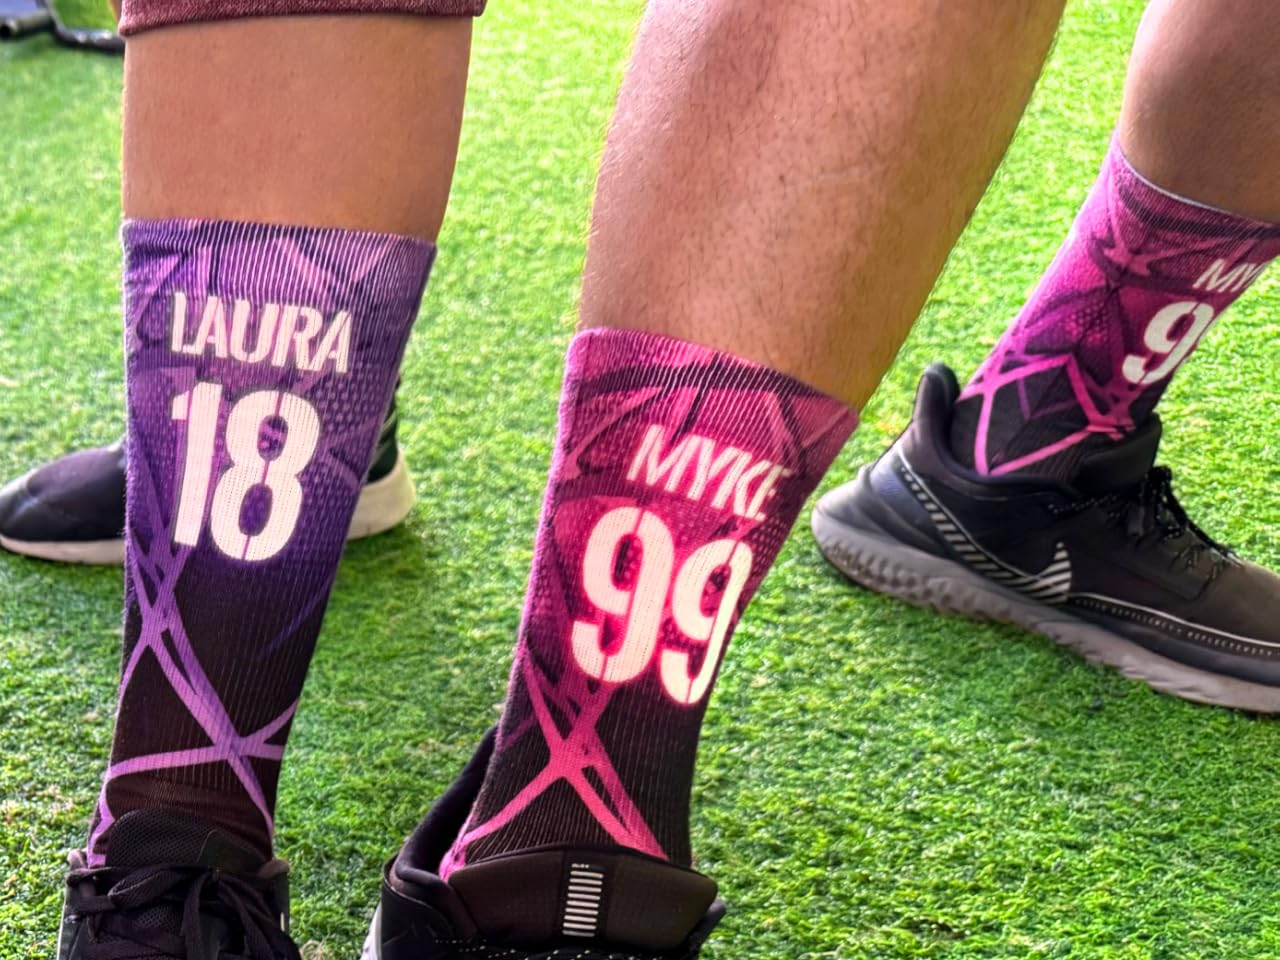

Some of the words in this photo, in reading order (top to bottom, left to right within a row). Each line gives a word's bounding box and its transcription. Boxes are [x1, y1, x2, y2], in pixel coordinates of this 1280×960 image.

[1192, 258, 1268, 293] MY
[172, 291, 352, 374] LAURA
[1122, 301, 1214, 385] 9
[171, 381, 320, 562] 18
[626, 424, 792, 521] MYKE
[572, 506, 753, 704] 99
